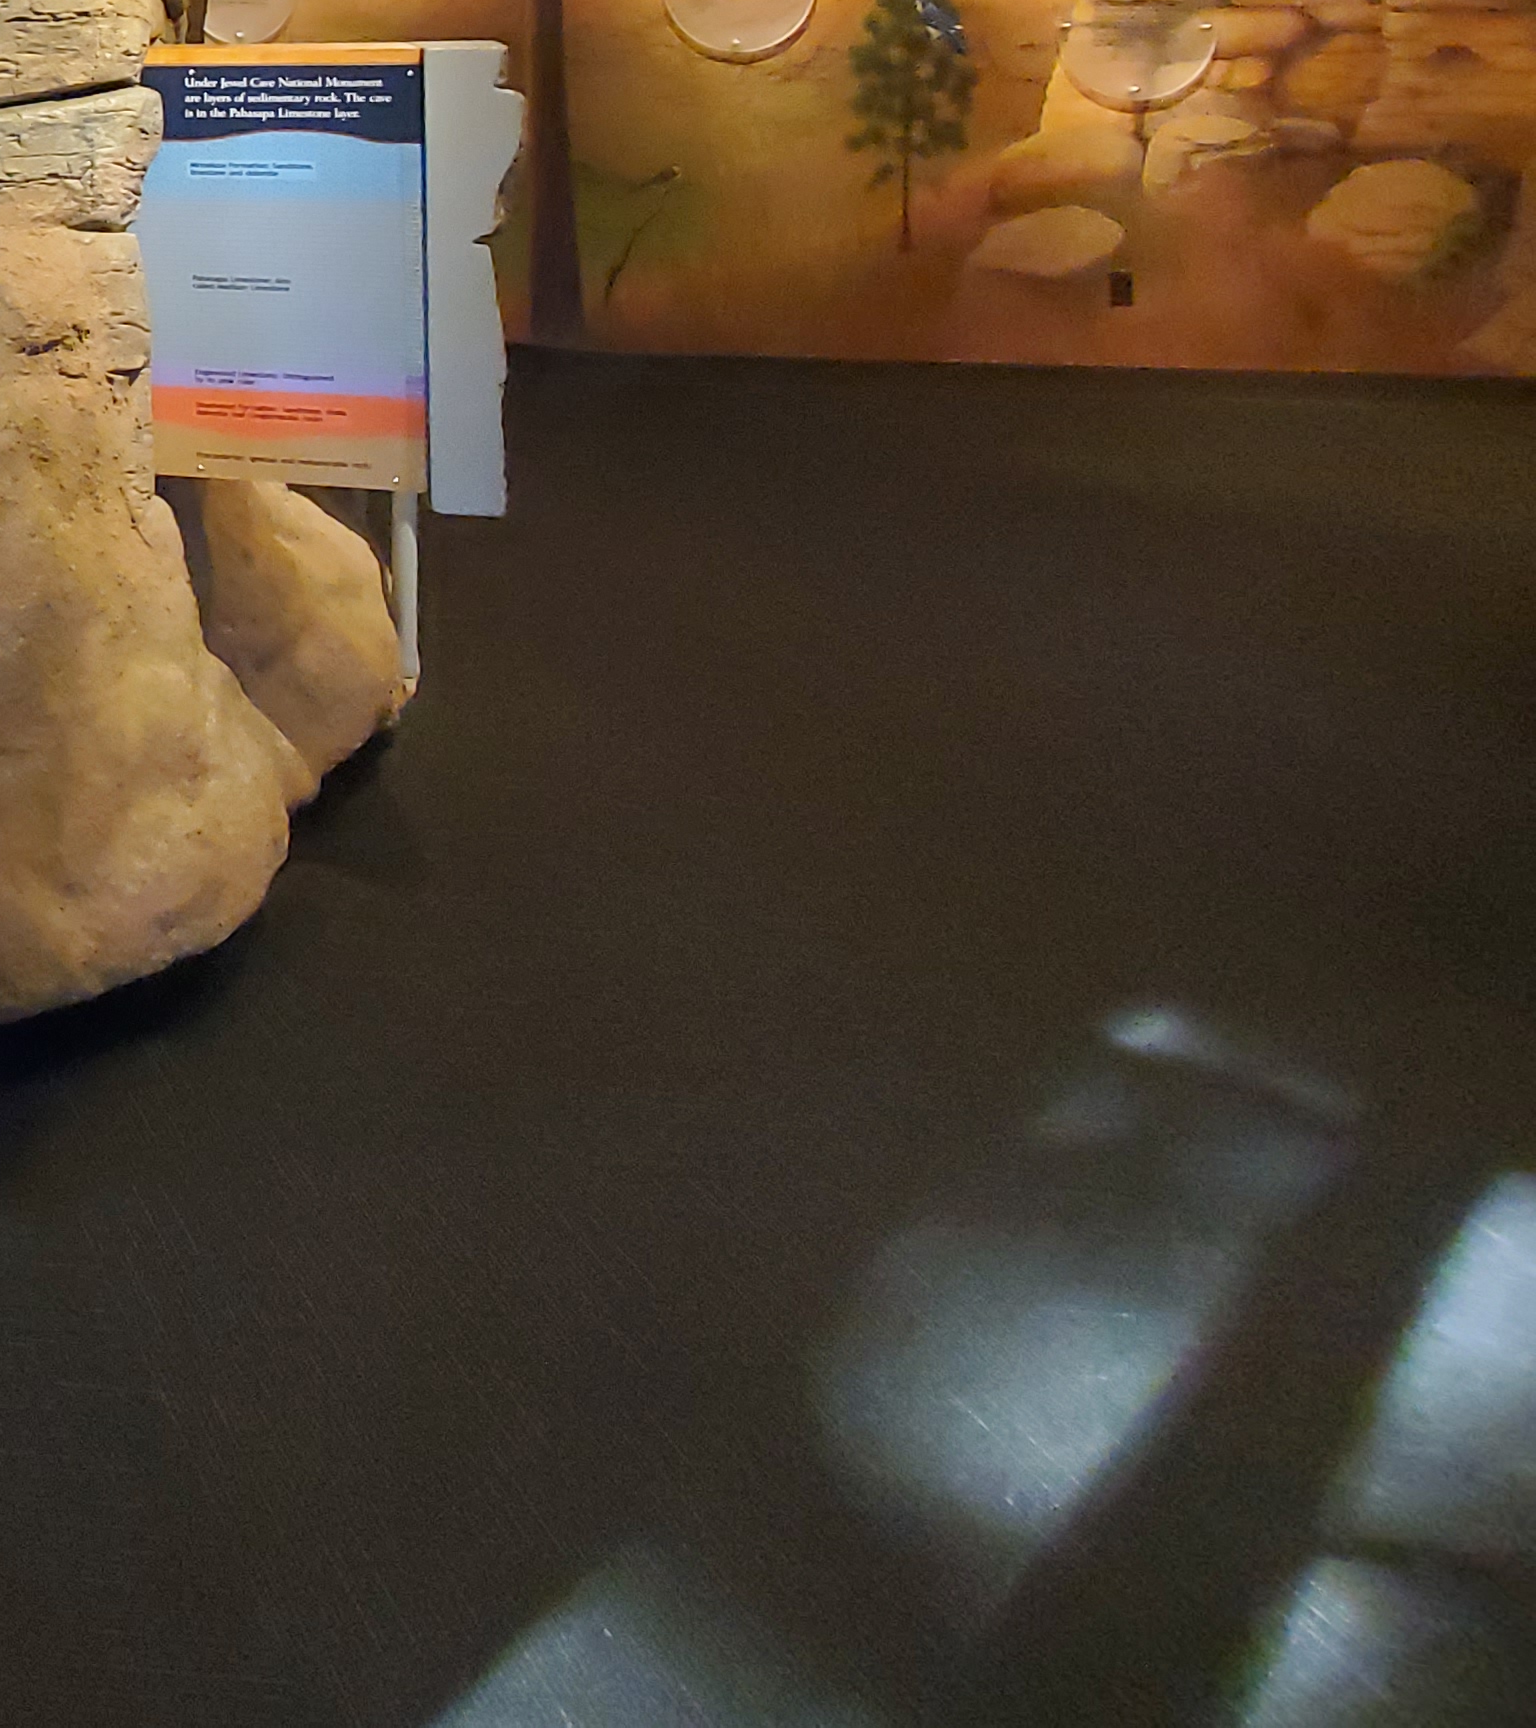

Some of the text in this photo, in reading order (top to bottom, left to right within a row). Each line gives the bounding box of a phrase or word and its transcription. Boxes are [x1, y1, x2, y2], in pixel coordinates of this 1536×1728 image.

[184, 76, 218, 88] Under
[277, 76, 322, 88] National
[184, 94, 202, 103] are
[203, 92, 232, 106] layers
[233, 92, 246, 103] of
[343, 92, 367, 103] The
